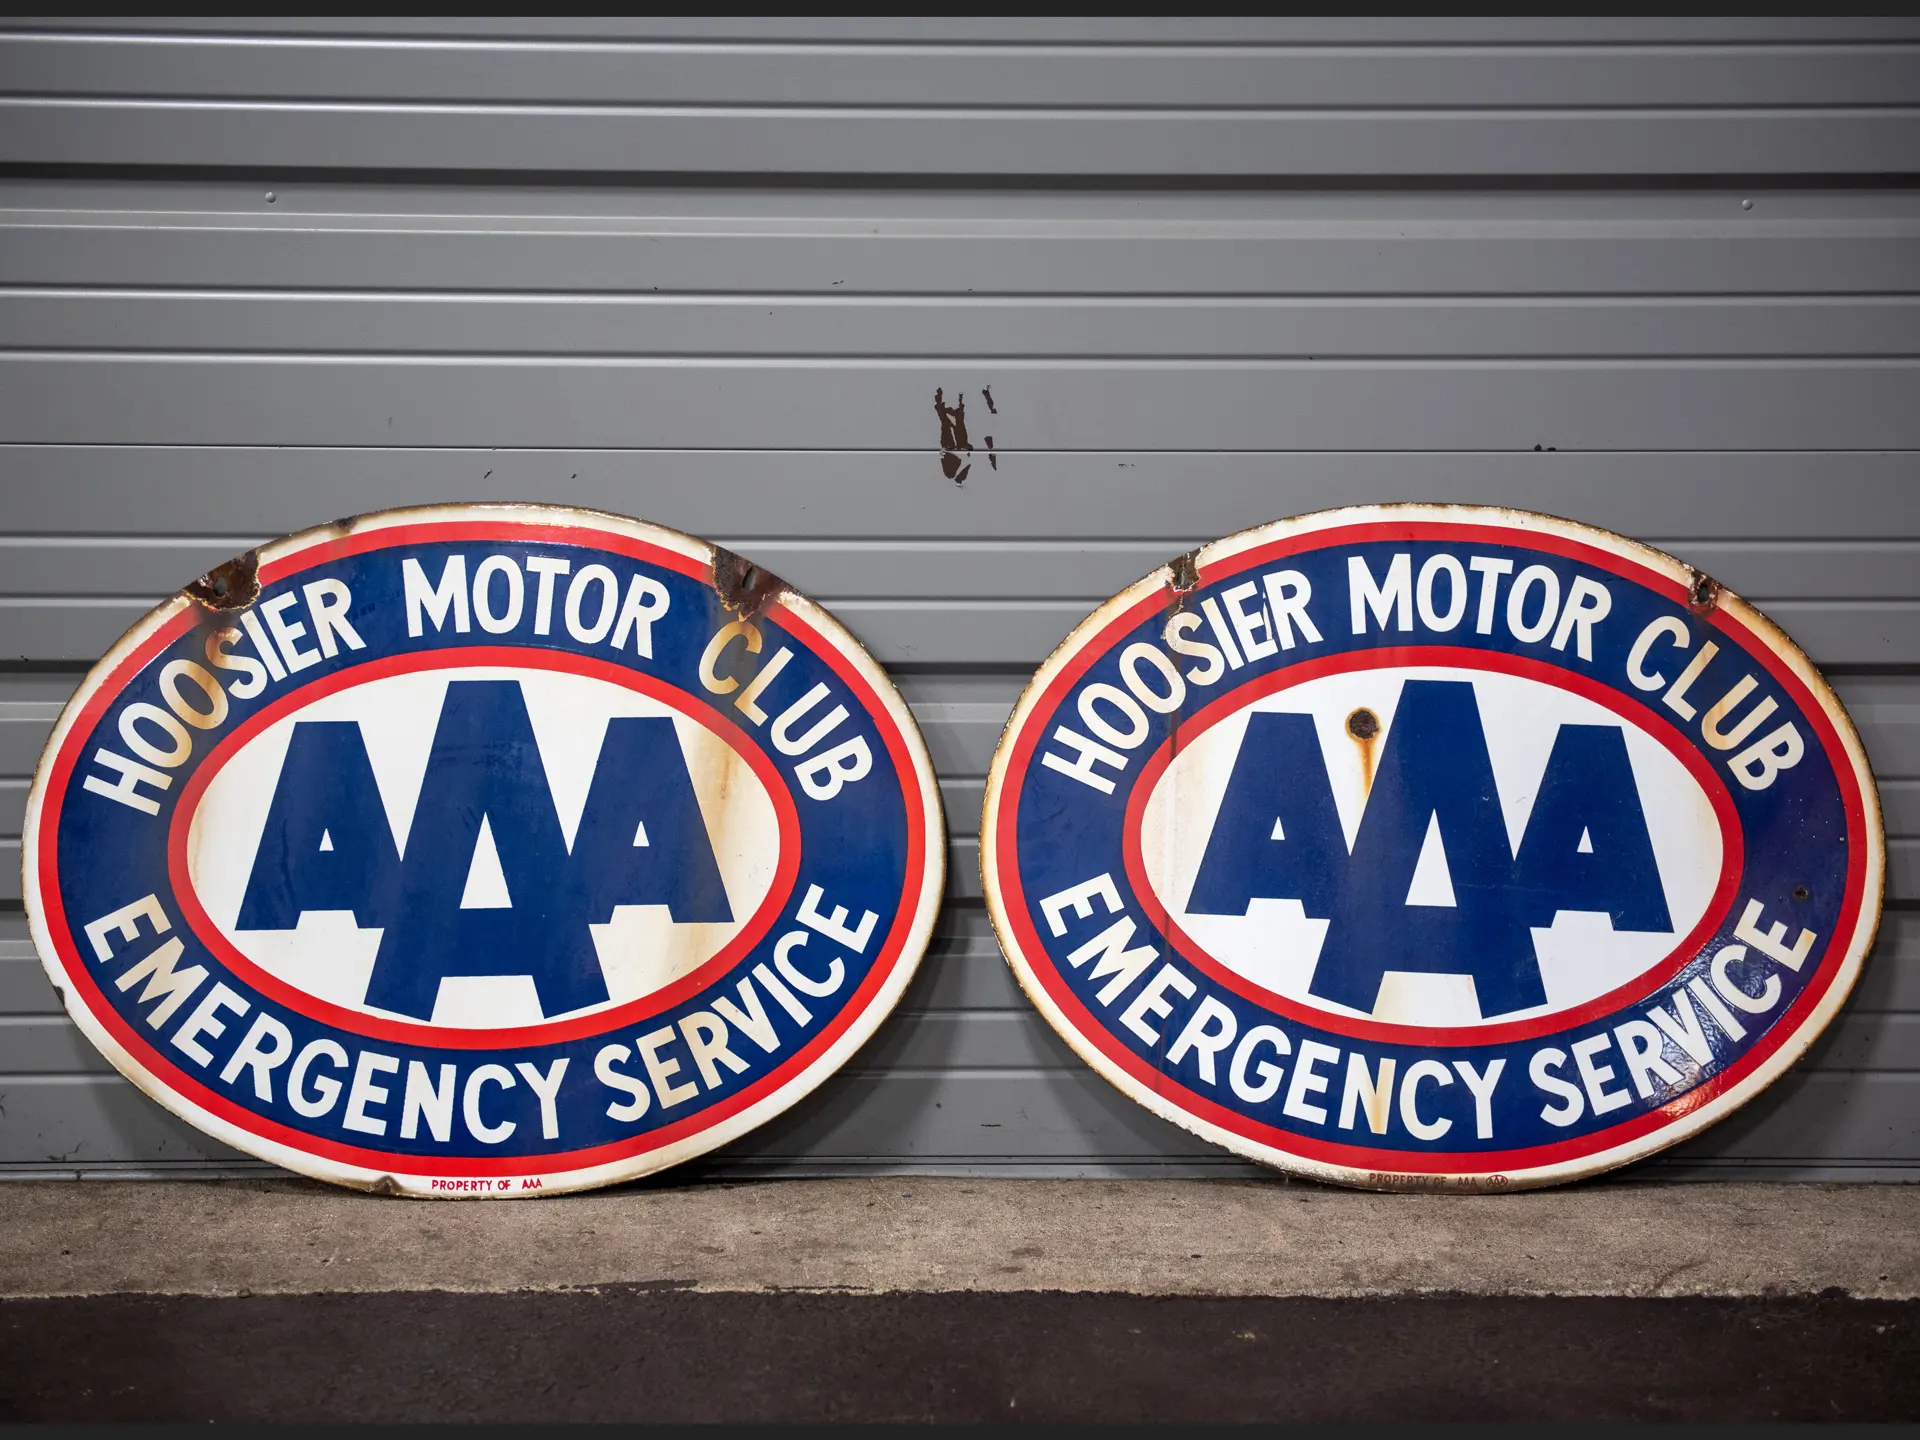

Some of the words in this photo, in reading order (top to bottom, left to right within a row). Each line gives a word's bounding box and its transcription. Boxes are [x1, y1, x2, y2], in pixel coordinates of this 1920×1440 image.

[82, 577, 366, 816] HOOSIER
[402, 554, 671, 659] MOTOR
[697, 620, 873, 801] CLUB
[1041, 569, 1324, 795] HOOSIER
[1348, 553, 1612, 662] MOTOR
[1625, 616, 1805, 791] CLUB
[235, 680, 735, 1022] AAA
[1184, 679, 1674, 1019] AAA
[83, 893, 571, 1145] EMERGENCY
[594, 883, 880, 1124] SERVICE
[1039, 873, 1506, 1141] EMERGENCY
[1530, 898, 1817, 1128] SERVICE
[431, 1179, 492, 1191] PROPERTY
[497, 1179, 511, 1190] OF
[521, 1178, 543, 1190] AAA
[1369, 1172, 1429, 1187] PROPERTY
[1456, 1176, 1477, 1188] AAA
